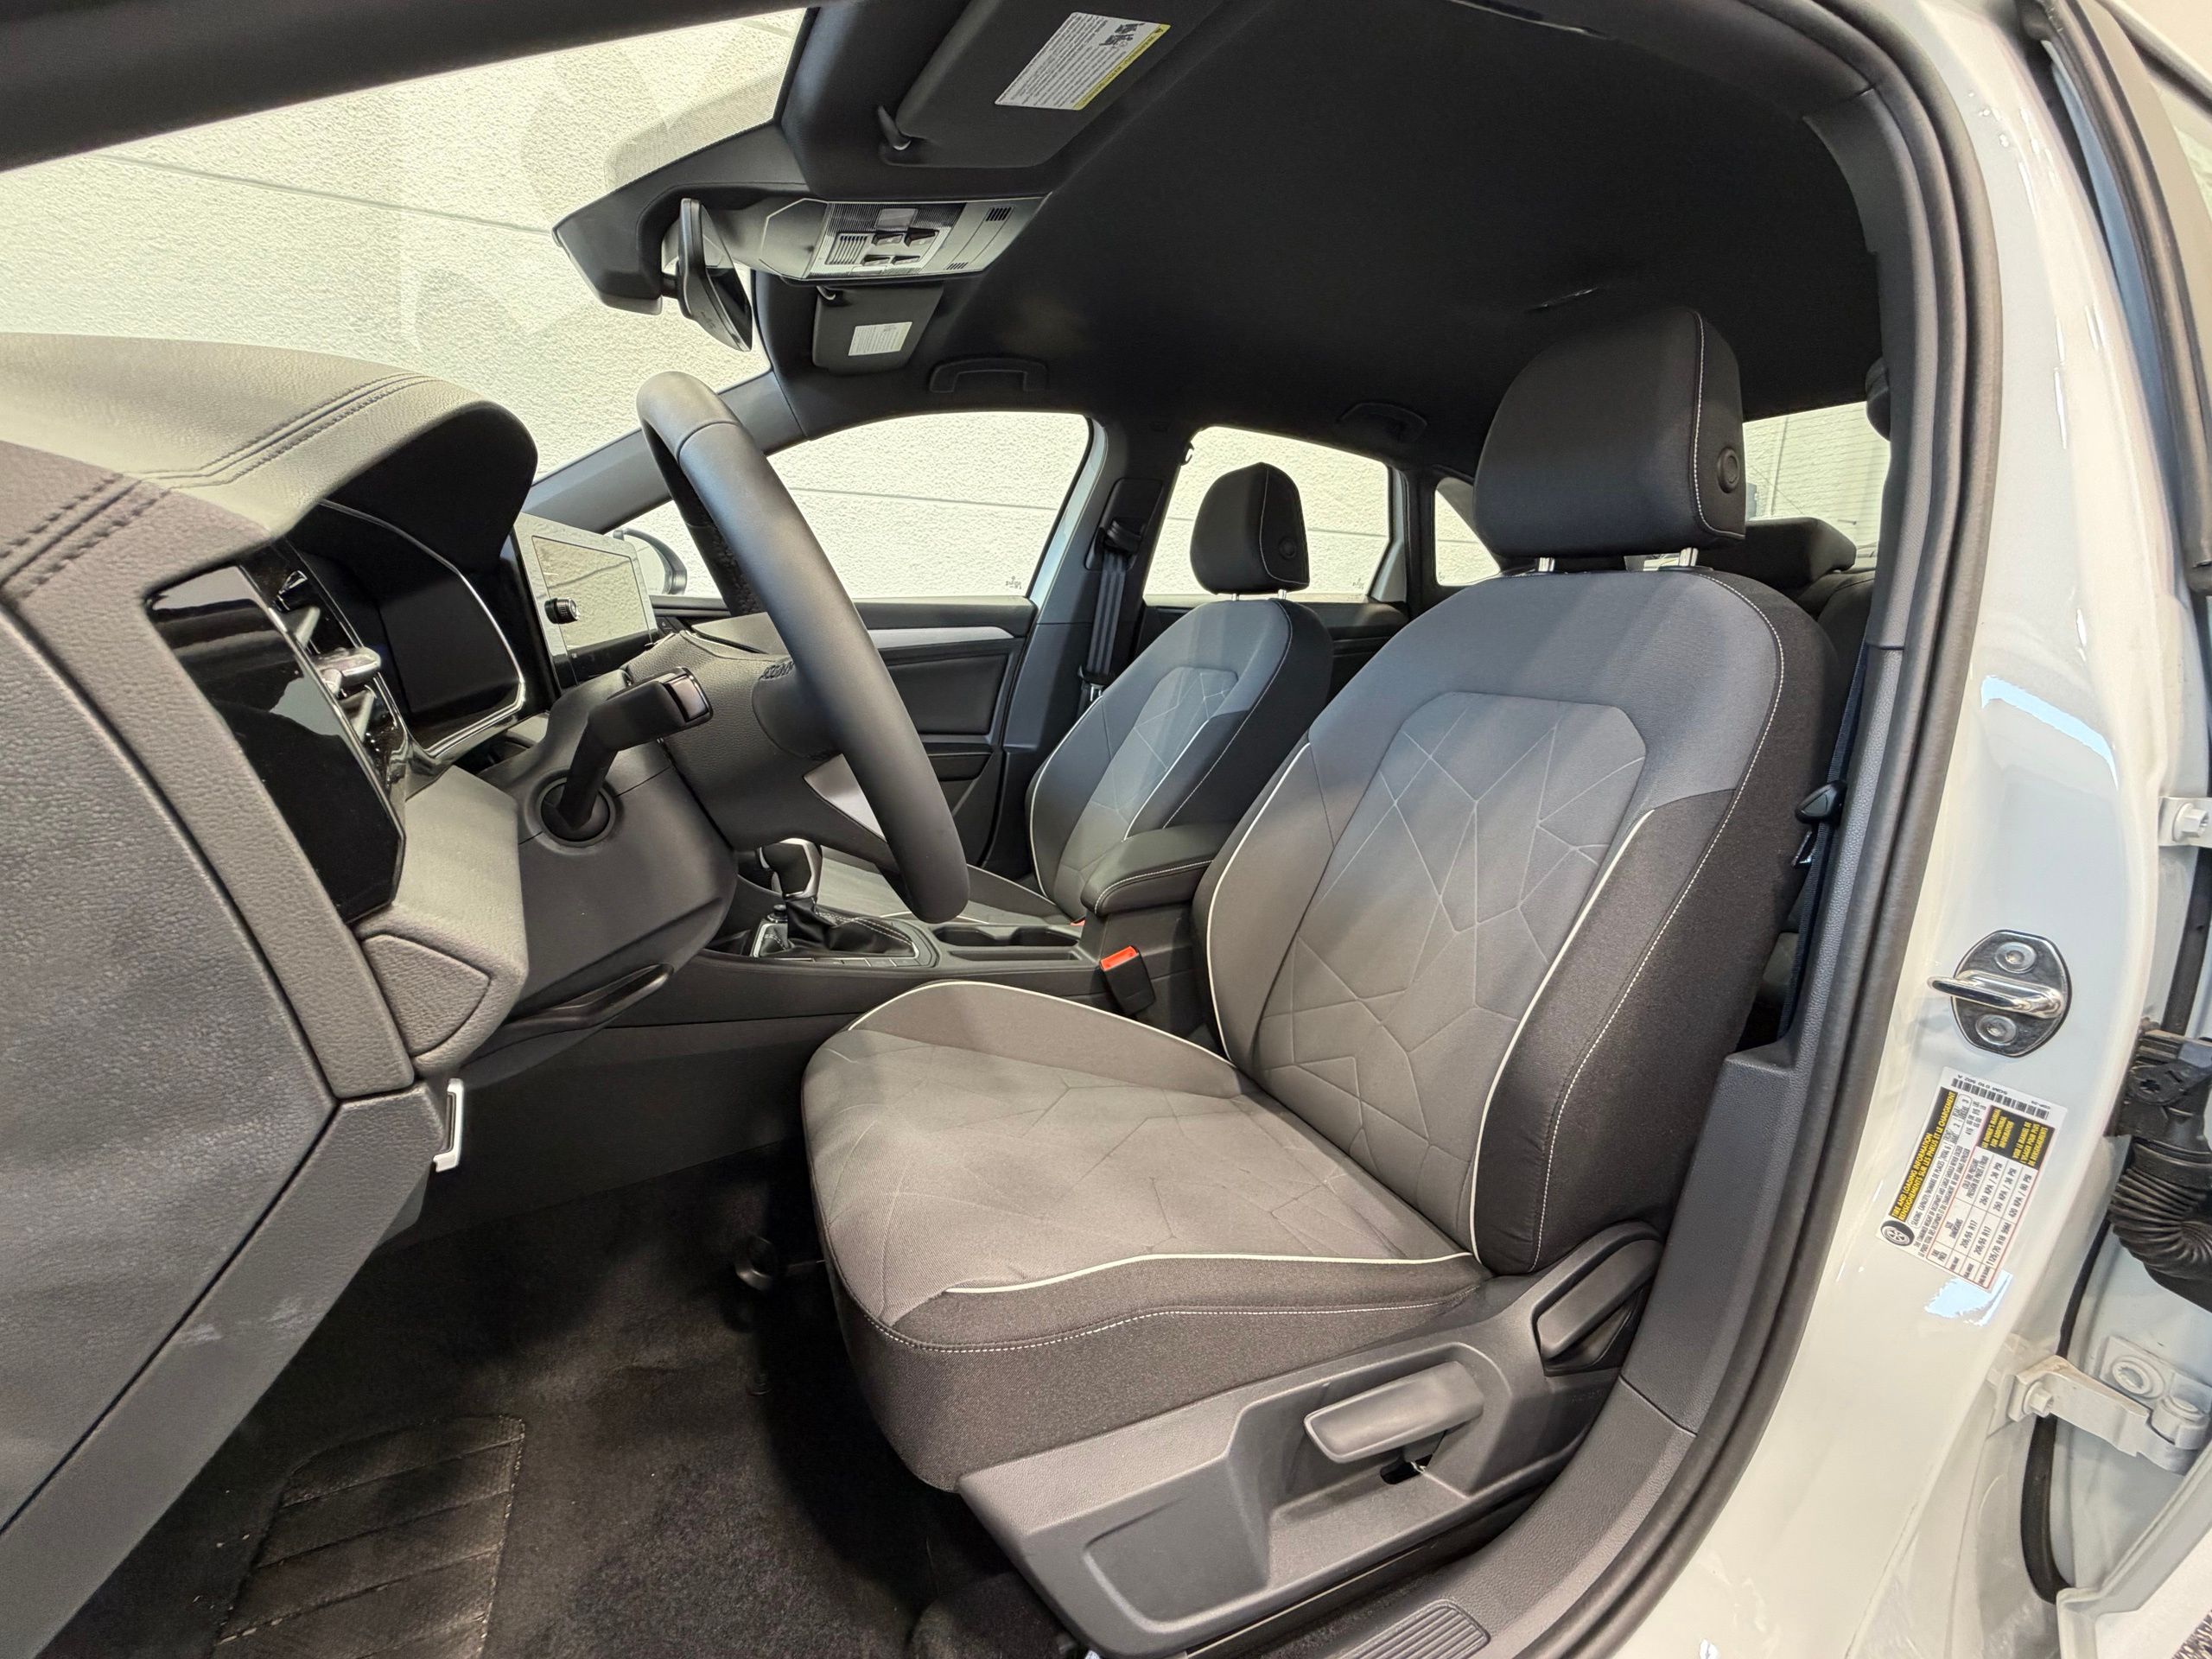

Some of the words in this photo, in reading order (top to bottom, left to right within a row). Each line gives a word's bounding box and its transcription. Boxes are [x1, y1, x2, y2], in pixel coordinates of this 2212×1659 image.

[1897, 1193, 1907, 1207] AND
[1903, 1169, 1917, 1194] LOADING
[1913, 1133, 1933, 1170] INFORMATION
[1899, 1176, 1923, 1220] RENSEIGNEMENTS
[1918, 1165, 1928, 1177] SUR
[1923, 1156, 1931, 1166] LES
[1927, 1139, 1938, 1157] PNEUS
[1938, 1091, 1955, 1126] CHARGEMENT
